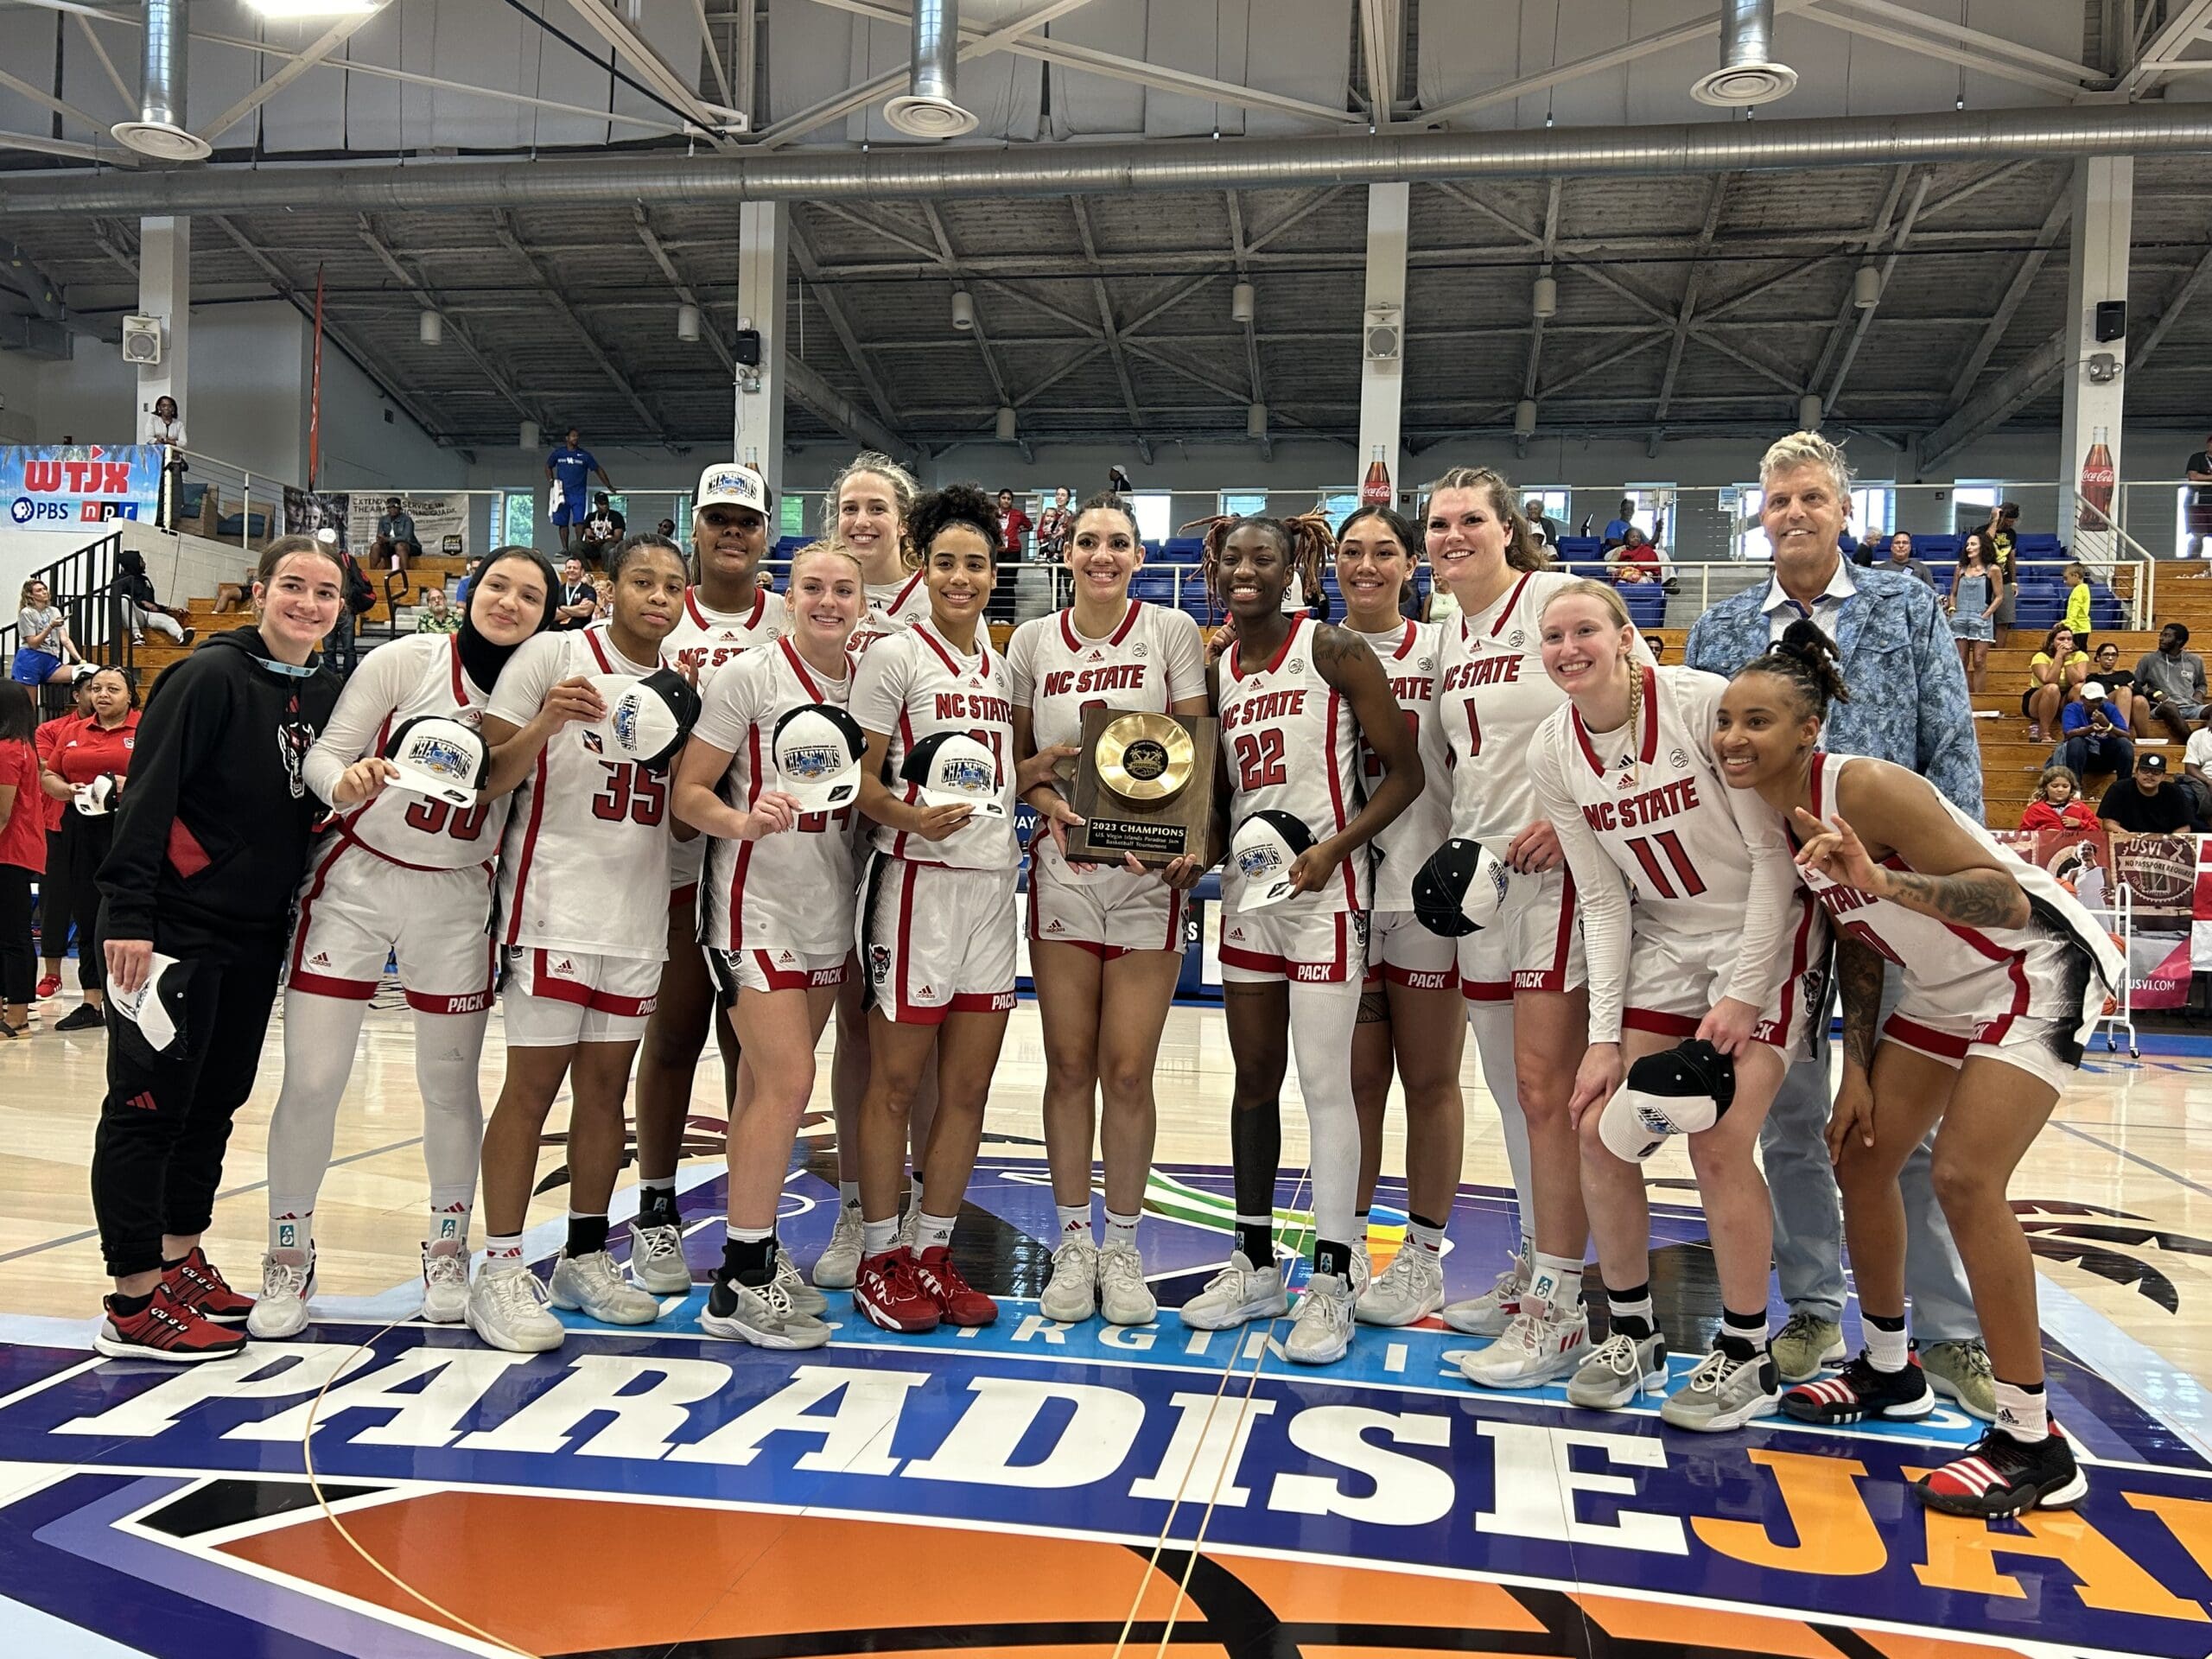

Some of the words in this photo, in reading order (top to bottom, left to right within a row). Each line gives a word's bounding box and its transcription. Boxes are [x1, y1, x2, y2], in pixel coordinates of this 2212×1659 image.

[24, 458, 131, 493] WTJX
[37, 503, 68, 519] PBS
[86, 504, 133, 522] npr
[402, 500, 434, 510] SERVICE
[678, 648, 709, 668] NC
[1043, 671, 1075, 698] NC
[1076, 664, 1147, 692] STATE
[1442, 666, 1459, 695] NC
[1458, 654, 1524, 688] STATE
[935, 693, 966, 721] NC
[967, 695, 1013, 725] STATE
[1220, 703, 1241, 734] NC
[1241, 690, 1308, 726] STATE
[1463, 698, 1481, 757] 1
[1233, 728, 1287, 792] 22
[592, 758, 668, 827] 35
[1582, 802, 1617, 831] NC
[1618, 776, 1700, 828] STATE
[1092, 822, 1116, 831] 2023
[1120, 823, 1185, 837] CHAMPIONS
[2130, 838, 2163, 856] USVI
[1624, 830, 1707, 899] 11
[2135, 861, 2165, 871] PASSPORT
[1817, 883, 1879, 915] TATE
[309, 958, 332, 968] adidas
[1297, 964, 1332, 981] PACK
[811, 968, 841, 986] PACK
[1408, 972, 1446, 989] PACK
[1514, 971, 1545, 988] PACK
[448, 993, 485, 1013] PACK
[1751, 1022, 1775, 1041] CK
[48, 1342, 1689, 1554] PARADISE
